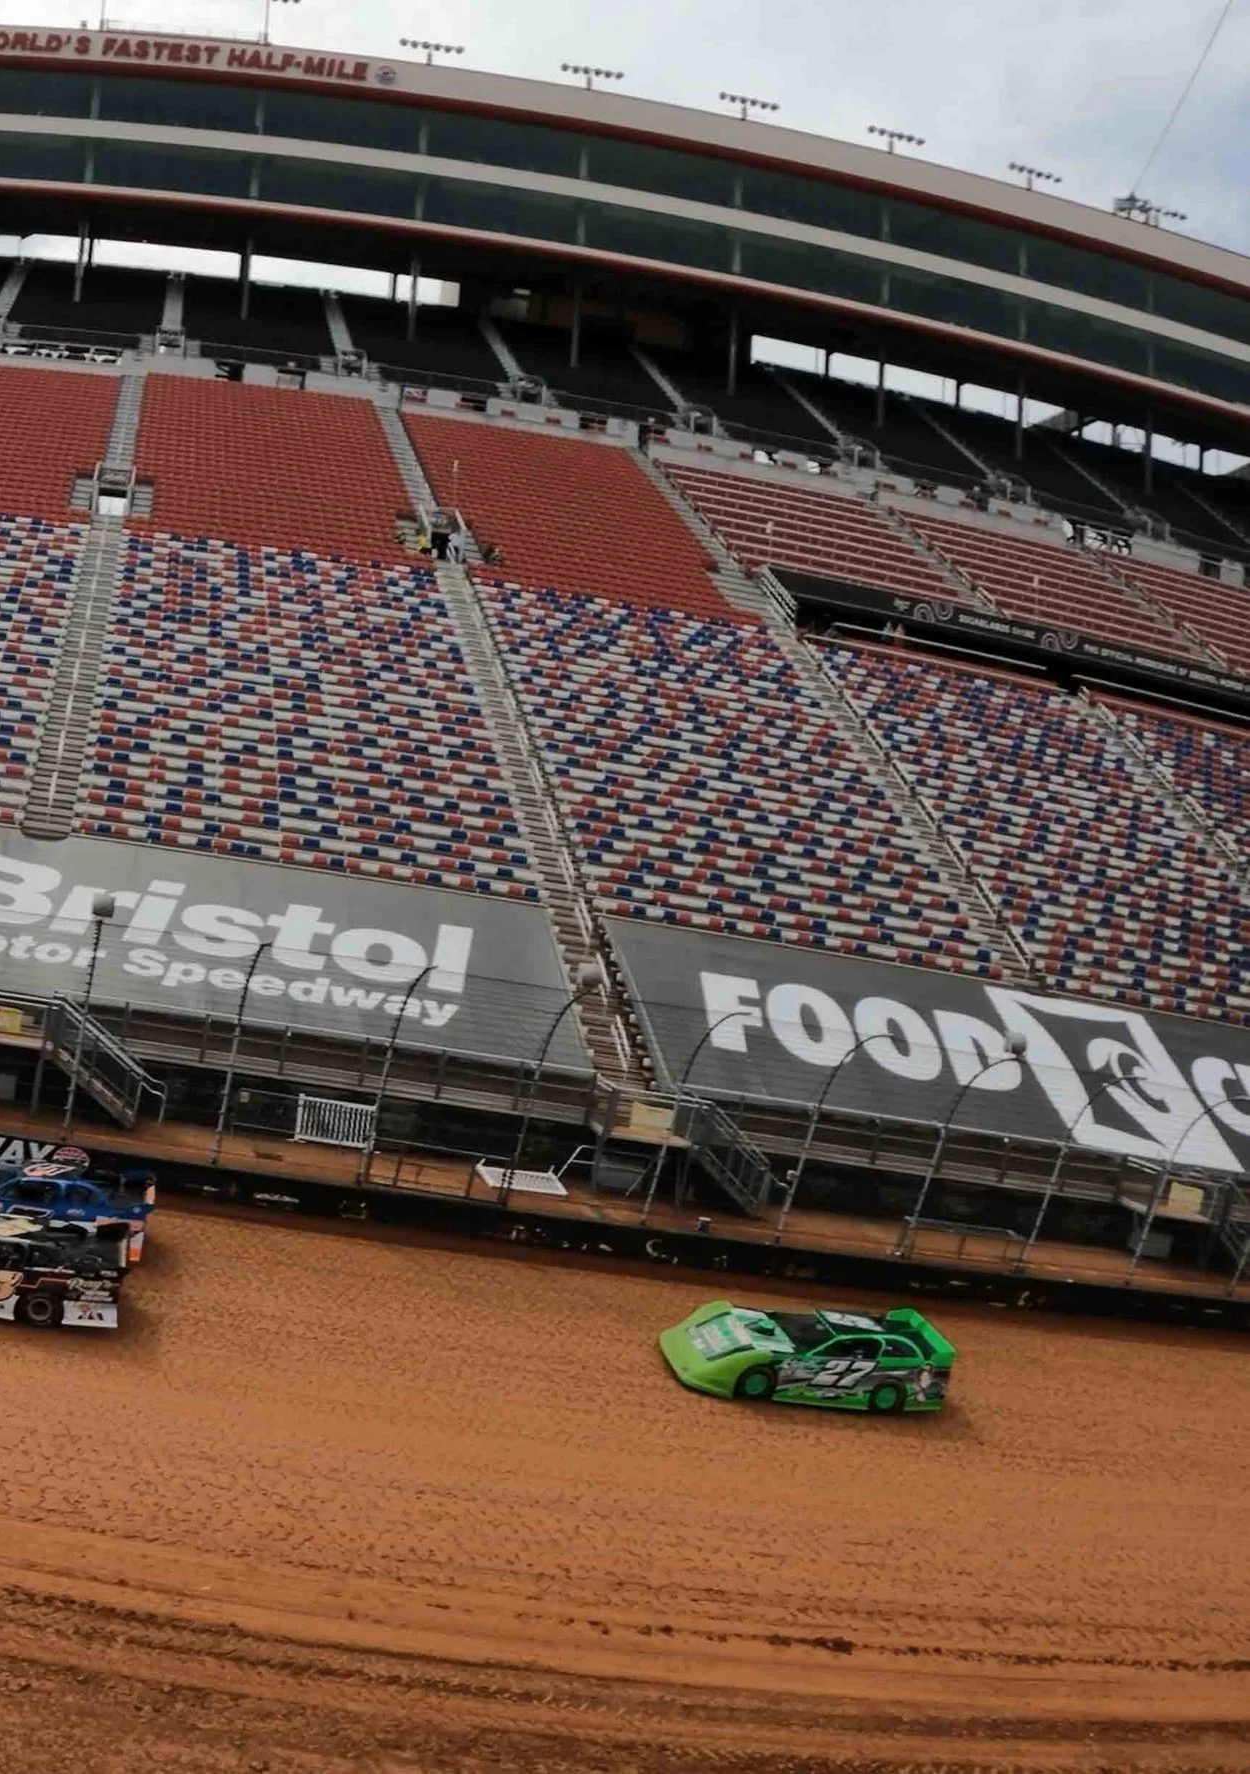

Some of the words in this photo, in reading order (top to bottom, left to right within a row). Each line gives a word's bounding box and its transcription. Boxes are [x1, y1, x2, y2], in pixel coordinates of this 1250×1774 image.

[101, 37, 221, 66] FASTEST
[226, 47, 368, 82] HALF-MILE
[122, 948, 460, 1027] Speedway
[699, 971, 1022, 1092] FOOD
[809, 1359, 879, 1388] 27
